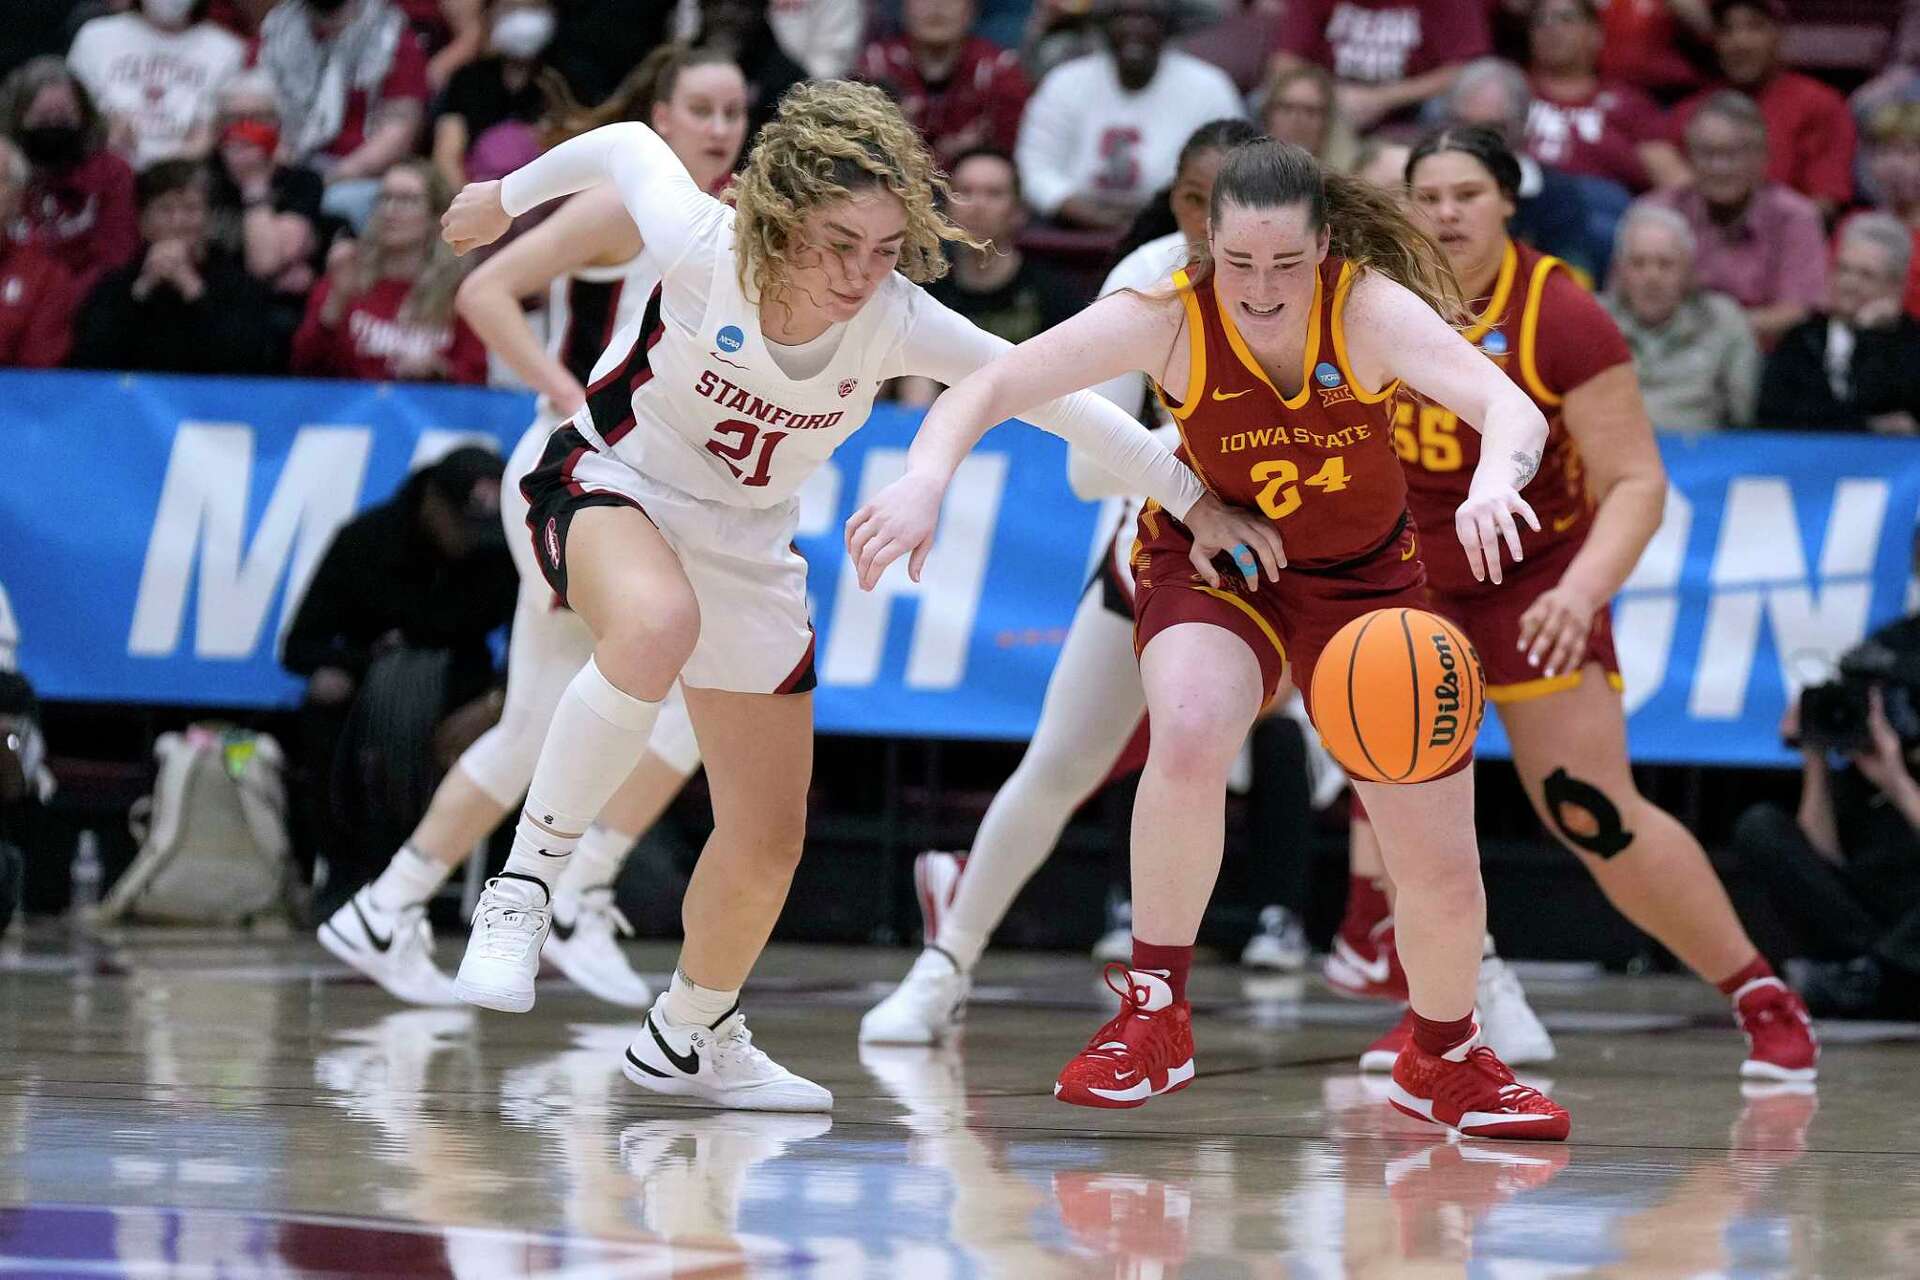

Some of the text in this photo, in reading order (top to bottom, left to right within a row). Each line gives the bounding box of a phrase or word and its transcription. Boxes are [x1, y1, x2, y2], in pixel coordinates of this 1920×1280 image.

[694, 369, 845, 430] STANFORD
[705, 418, 789, 487] 21
[1220, 423, 1372, 454] IOWA STATE
[1250, 456, 1352, 520] 24
[1429, 634, 1460, 748] Wilson
